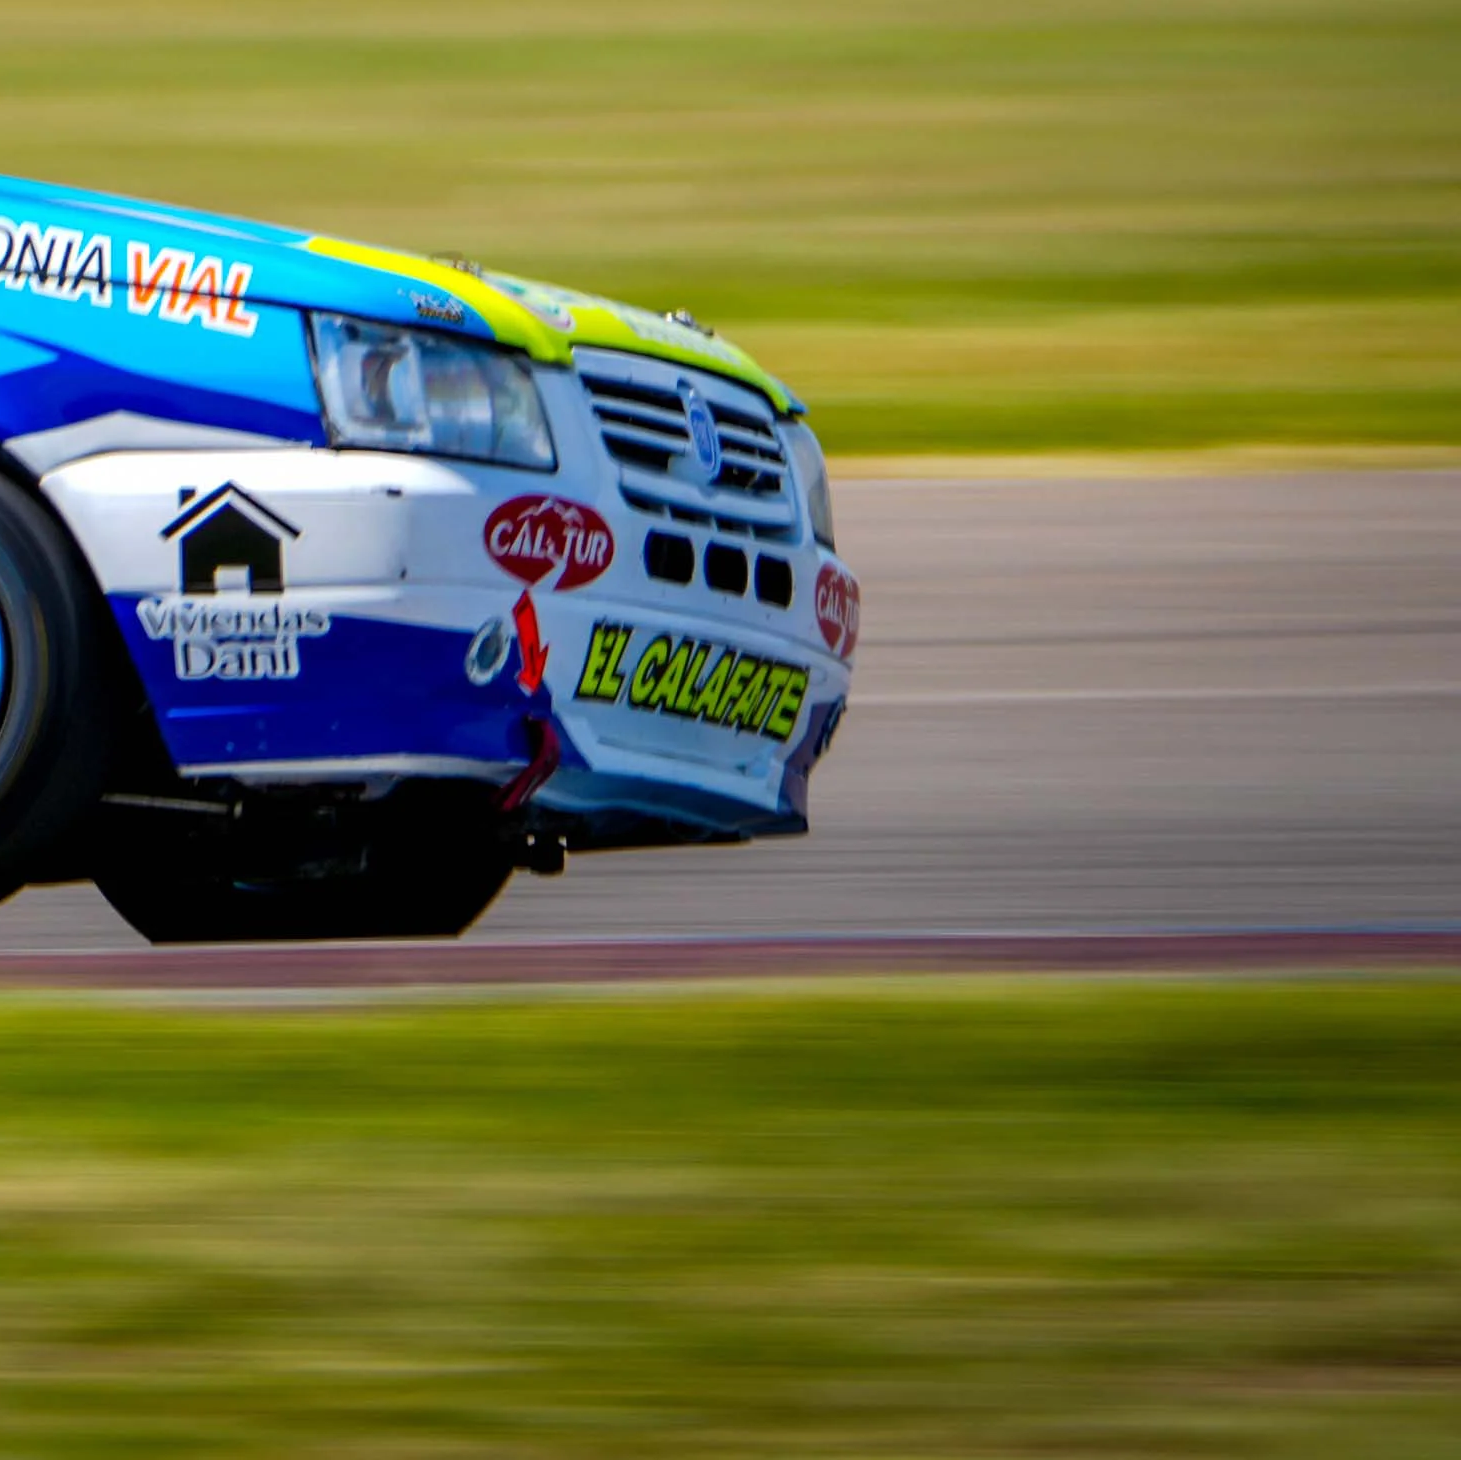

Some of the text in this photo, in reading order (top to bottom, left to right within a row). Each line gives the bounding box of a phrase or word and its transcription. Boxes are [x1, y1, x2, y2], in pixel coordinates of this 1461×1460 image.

[129, 244, 255, 329] VIAL
[138, 597, 330, 638] Viviendas
[178, 637, 299, 678] Dani
[573, 616, 811, 742] EL CALAFATE
